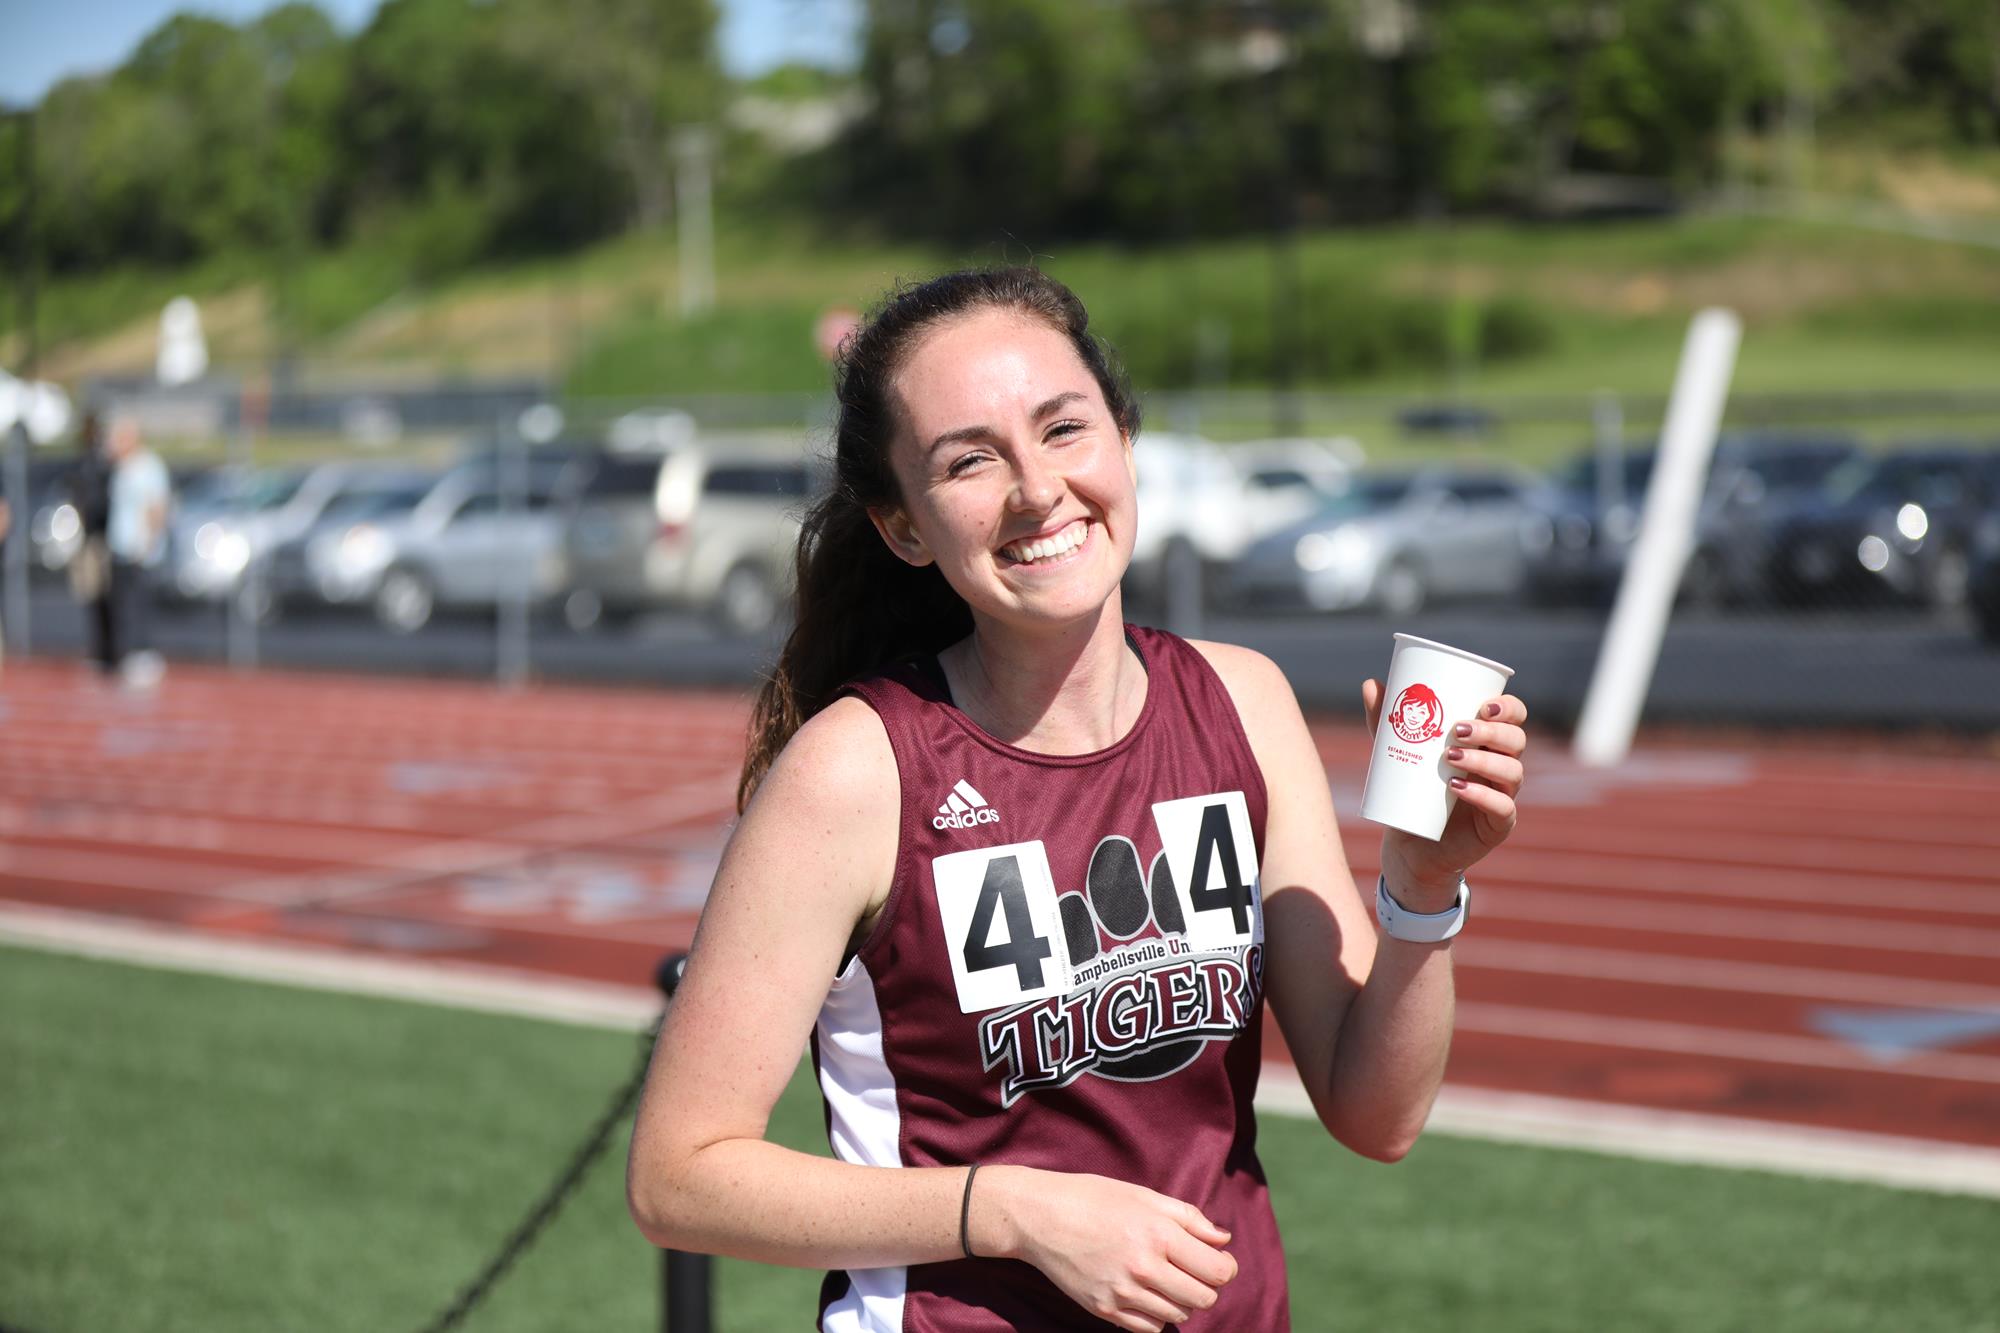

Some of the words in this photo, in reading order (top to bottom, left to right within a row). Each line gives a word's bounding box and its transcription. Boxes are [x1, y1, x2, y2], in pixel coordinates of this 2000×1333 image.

[1387, 745, 1423, 761] ESTABLISHED
[1396, 755, 1409, 763] 1969
[932, 807, 1000, 830] adidas
[1189, 803, 1253, 936] 4
[963, 854, 1052, 992] 4
[1073, 943, 1166, 986] ampbellsville
